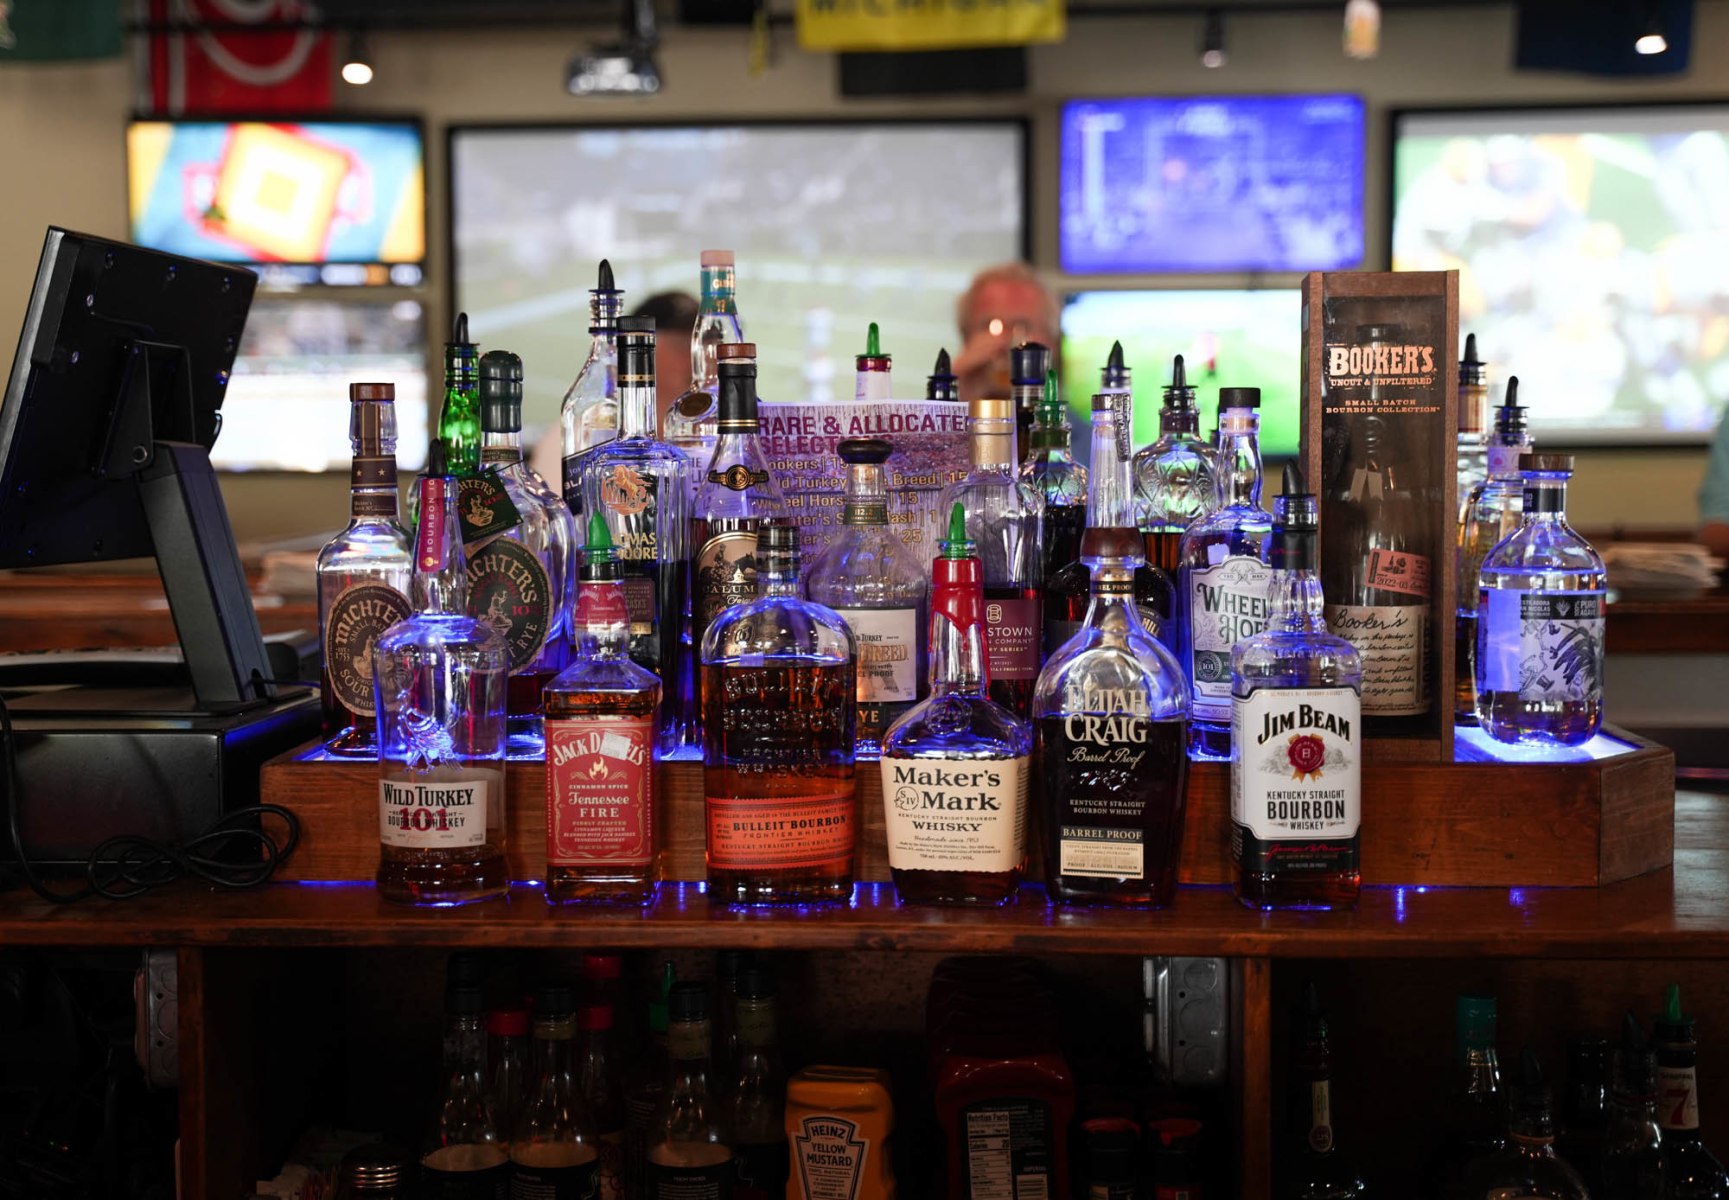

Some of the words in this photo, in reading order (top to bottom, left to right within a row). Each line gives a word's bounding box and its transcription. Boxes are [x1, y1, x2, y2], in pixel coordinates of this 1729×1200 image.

[1329, 346, 1434, 376] BOOKER'S
[1374, 377, 1432, 386] UNFILTERED
[757, 416, 815, 436] RARE
[823, 416, 842, 435] &
[848, 414, 969, 434] ALLOCATE
[770, 458, 817, 470] ookers
[458, 479, 496, 496] HTER'S
[797, 475, 848, 491] Turkey
[893, 474, 936, 485] Breed
[810, 494, 845, 506] Hors
[899, 491, 918, 504] 15
[426, 497, 436, 553] BOURBON
[616, 532, 656, 545] OMAS
[902, 529, 922, 543] 25
[468, 554, 538, 605] ICHTER'S
[335, 600, 403, 645] MICHTE
[1333, 609, 1409, 632] Booker's
[516, 622, 538, 649] RYE
[988, 627, 1033, 637] STOWN
[340, 669, 370, 698] SOUR
[1066, 684, 1148, 718] ELIJAH
[859, 710, 880, 723] YE
[1257, 711, 1295, 745] JIM
[1298, 704, 1351, 742] BEAM
[1065, 713, 1148, 746] CRAIG
[552, 738, 590, 767] JACK
[1067, 747, 1112, 763] Barrel
[1109, 748, 1146, 770] Proof
[892, 766, 1001, 788] Maker's
[383, 783, 415, 807] WILD
[415, 786, 475, 808] TURKEY
[568, 792, 630, 806] Tennessee
[921, 791, 1000, 811] Mark
[1266, 790, 1307, 800] KENTUCKY
[1309, 789, 1345, 800] STRAIGHT
[1069, 799, 1107, 807] KENTUCKY
[1109, 800, 1146, 808] STRAIGHT
[1073, 807, 1108, 815] BOURBON
[1109, 808, 1142, 816] WHISKEY
[1267, 800, 1346, 820] BOURBON
[399, 807, 450, 832] 101
[579, 808, 620, 818] FIRE
[733, 820, 785, 832] BULLEIT
[790, 815, 847, 829] BOURBON
[797, 828, 839, 836] WHISKEY
[912, 820, 983, 832] WHISKY
[1290, 821, 1325, 831] WHISKEY
[1063, 828, 1105, 838] BARREL
[1106, 830, 1143, 840] PROOF
[797, 839, 830, 847] BOURBON
[1664, 1088, 1691, 1126] 7
[810, 1125, 846, 1139] HEINZ
[811, 1142, 847, 1154] YELLOW
[806, 1154, 852, 1167] MUSTARD
